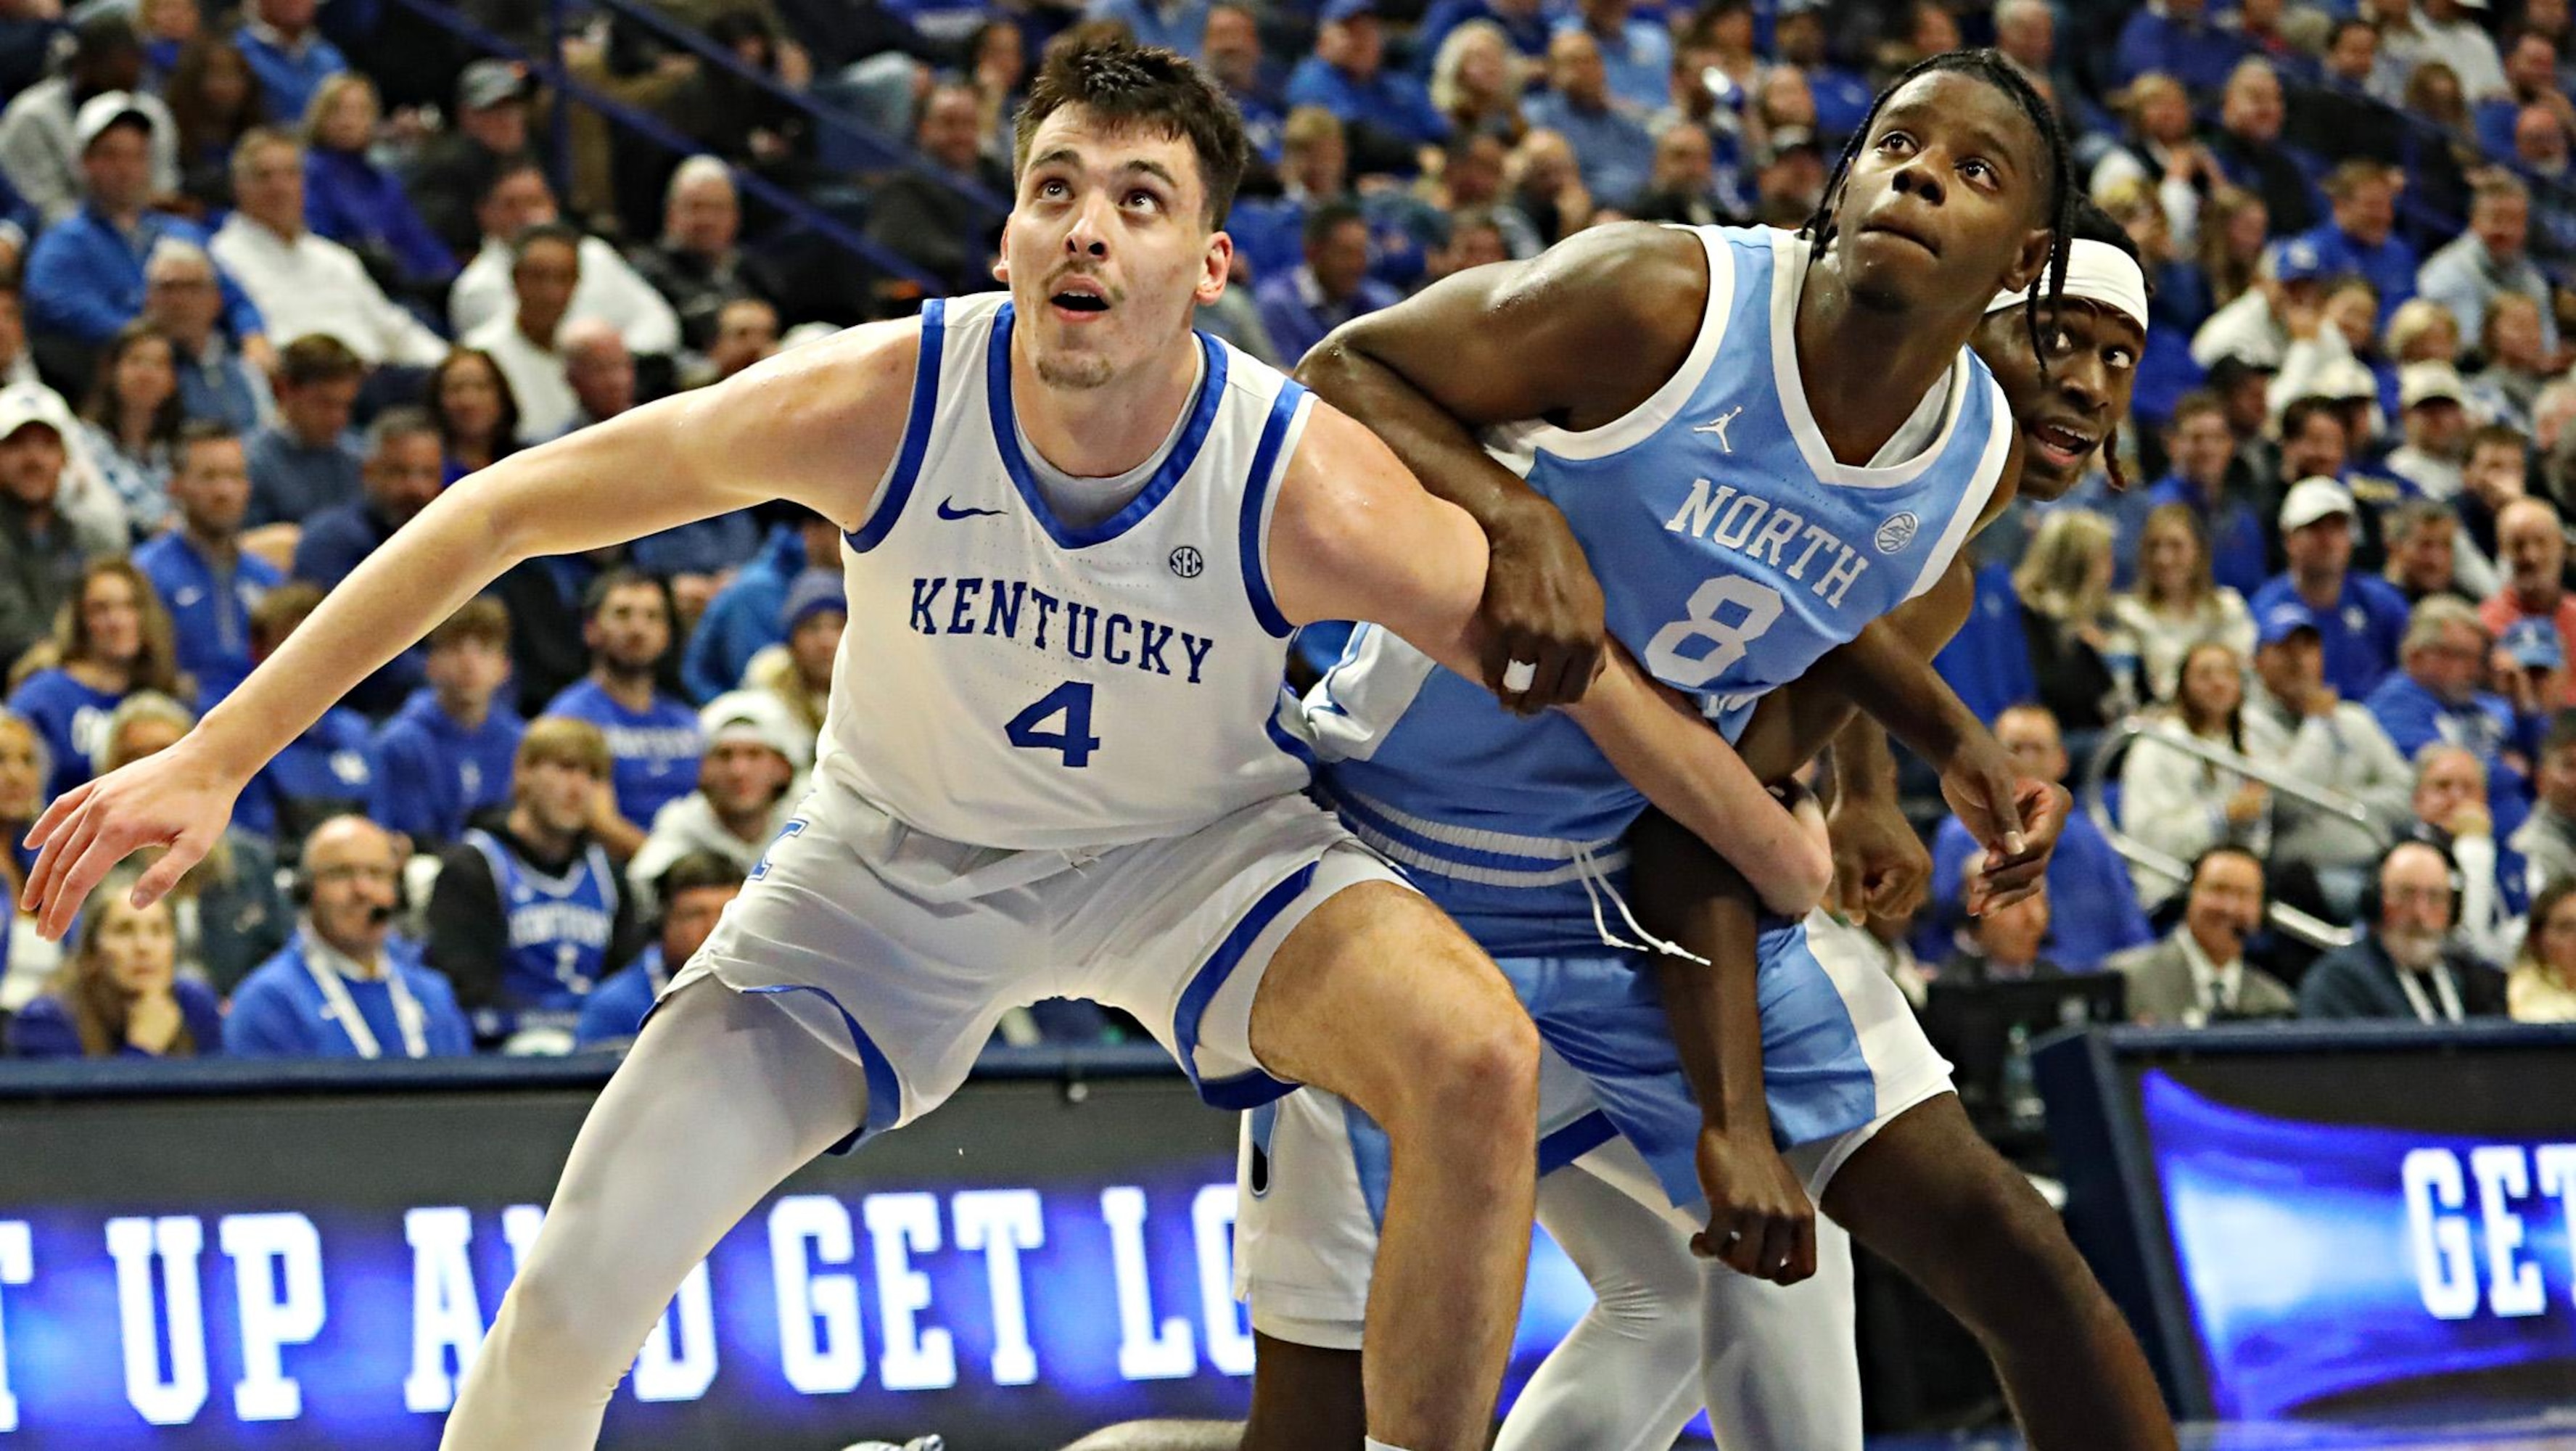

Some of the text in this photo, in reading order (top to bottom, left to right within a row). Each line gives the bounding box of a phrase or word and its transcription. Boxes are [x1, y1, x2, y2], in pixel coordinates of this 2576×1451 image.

[1170, 546, 1202, 577] SEC
[1665, 478, 1869, 609] NORTH
[910, 577, 1213, 683] KENTUCKY
[1644, 574, 1785, 688] 8
[1004, 681, 1100, 767] 4
[105, 1212, 326, 1425] UP
[768, 1188, 1046, 1395] GET
